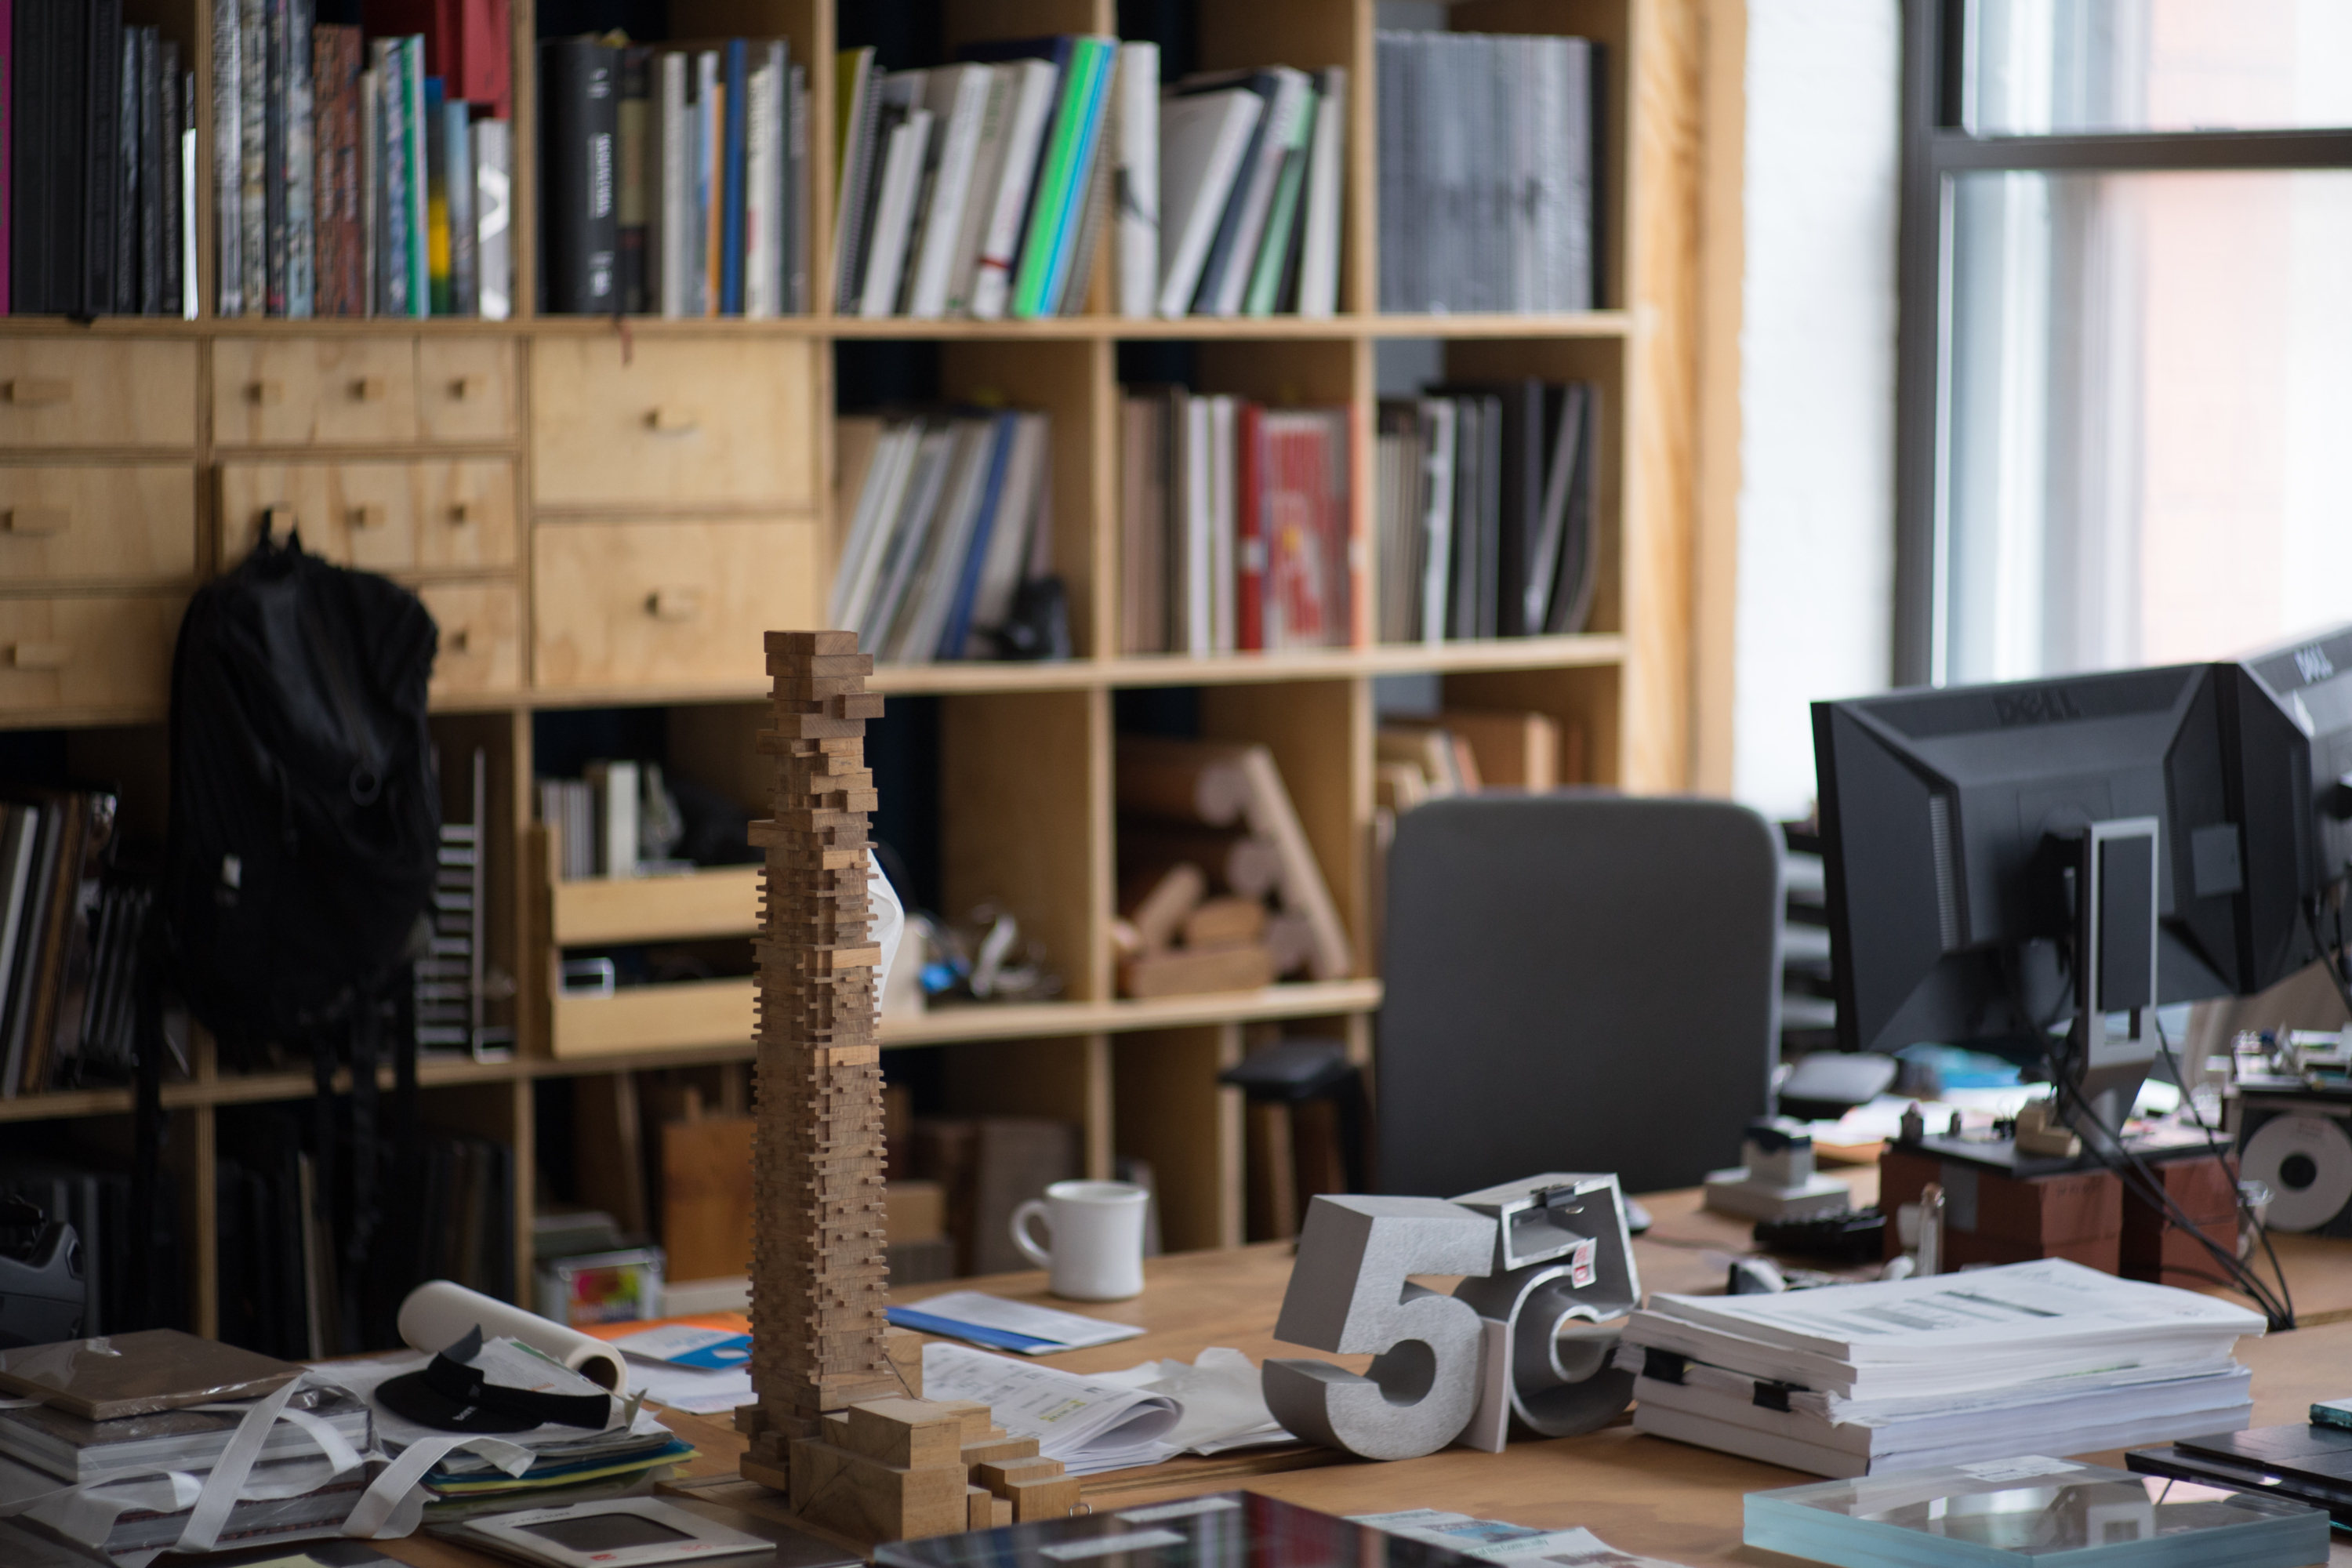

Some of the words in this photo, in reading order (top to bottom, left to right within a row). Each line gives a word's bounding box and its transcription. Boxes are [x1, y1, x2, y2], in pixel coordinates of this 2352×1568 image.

[2294, 644, 2334, 684] DELL
[1991, 688, 2082, 726] DELL
[1321, 1207, 1499, 1461] 5
[1501, 1538, 1549, 1552] Community
